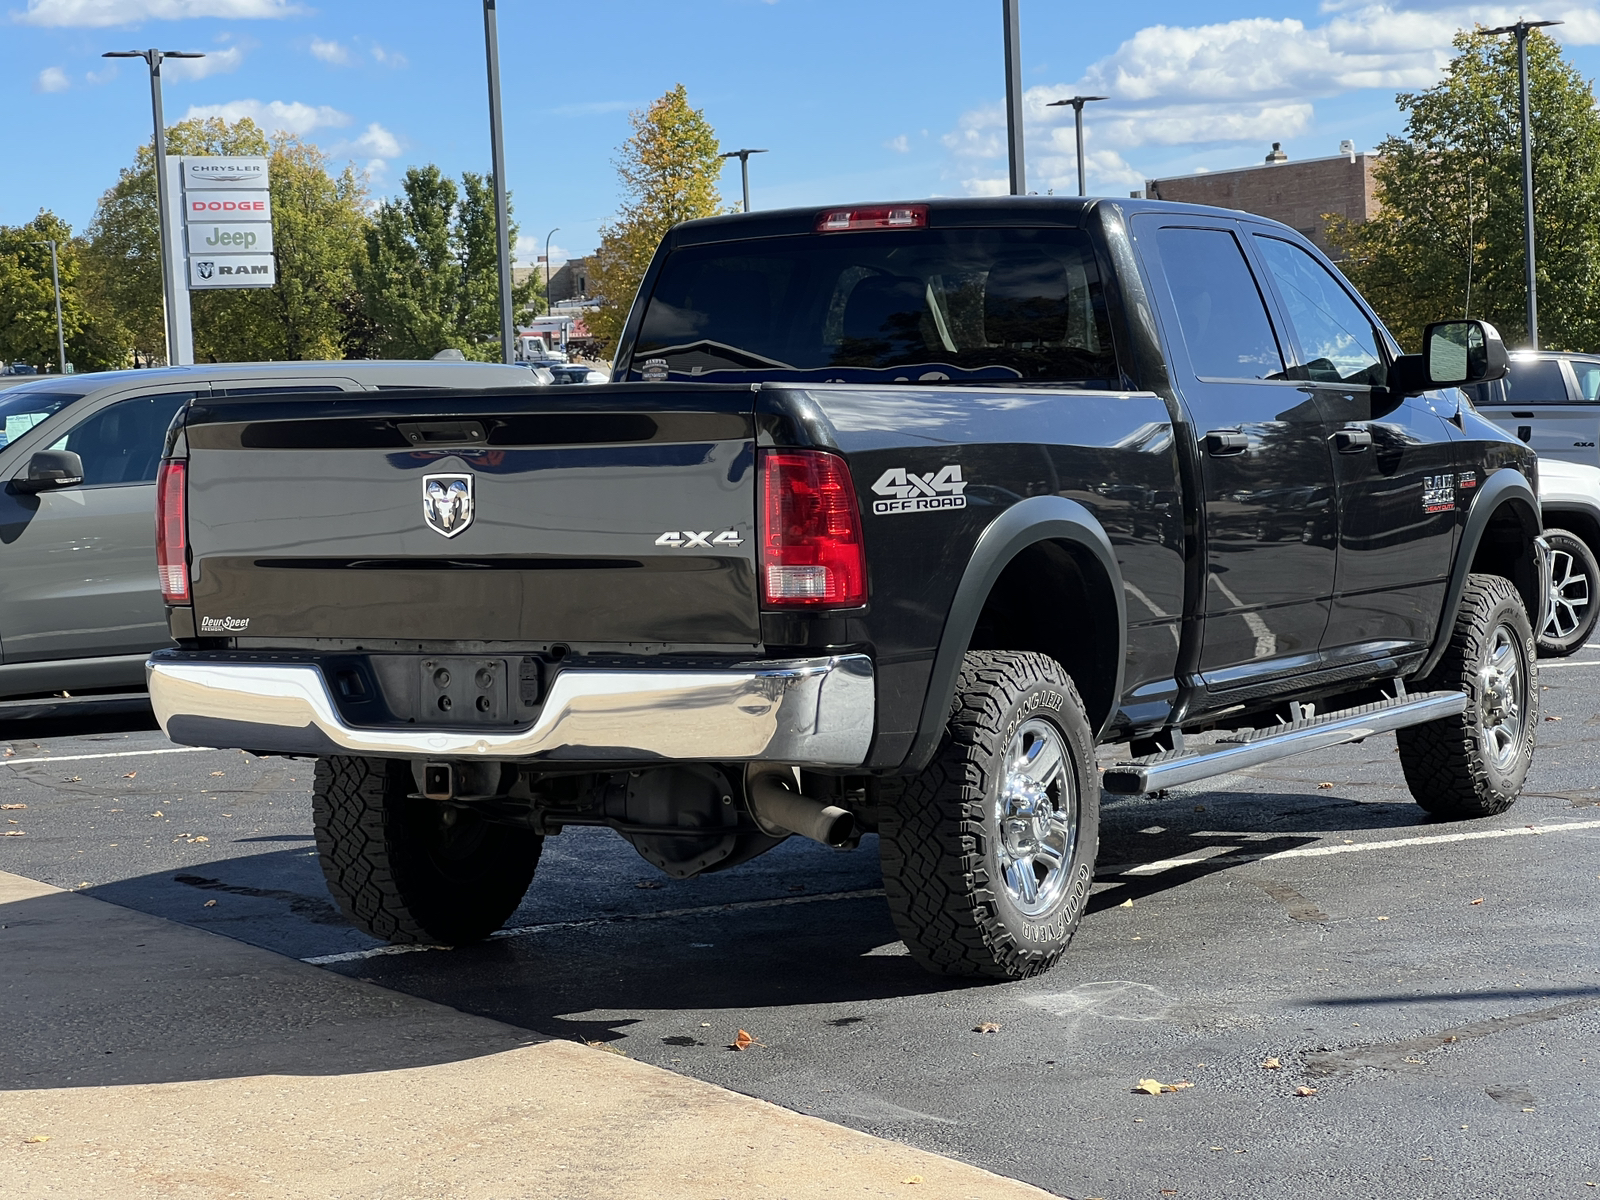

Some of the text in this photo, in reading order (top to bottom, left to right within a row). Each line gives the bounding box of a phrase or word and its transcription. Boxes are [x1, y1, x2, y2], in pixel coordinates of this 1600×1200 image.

[192, 201, 265, 211] DODGE
[205, 227, 257, 249] Jeep
[219, 265, 269, 275] RAM
[1423, 474, 1454, 491] RAM
[875, 498, 965, 512] OFF ROAD
[1426, 503, 1455, 513] HEAVY DUTY
[201, 616, 249, 628] Deur Speet
[1000, 690, 1064, 762] WRANGLER
